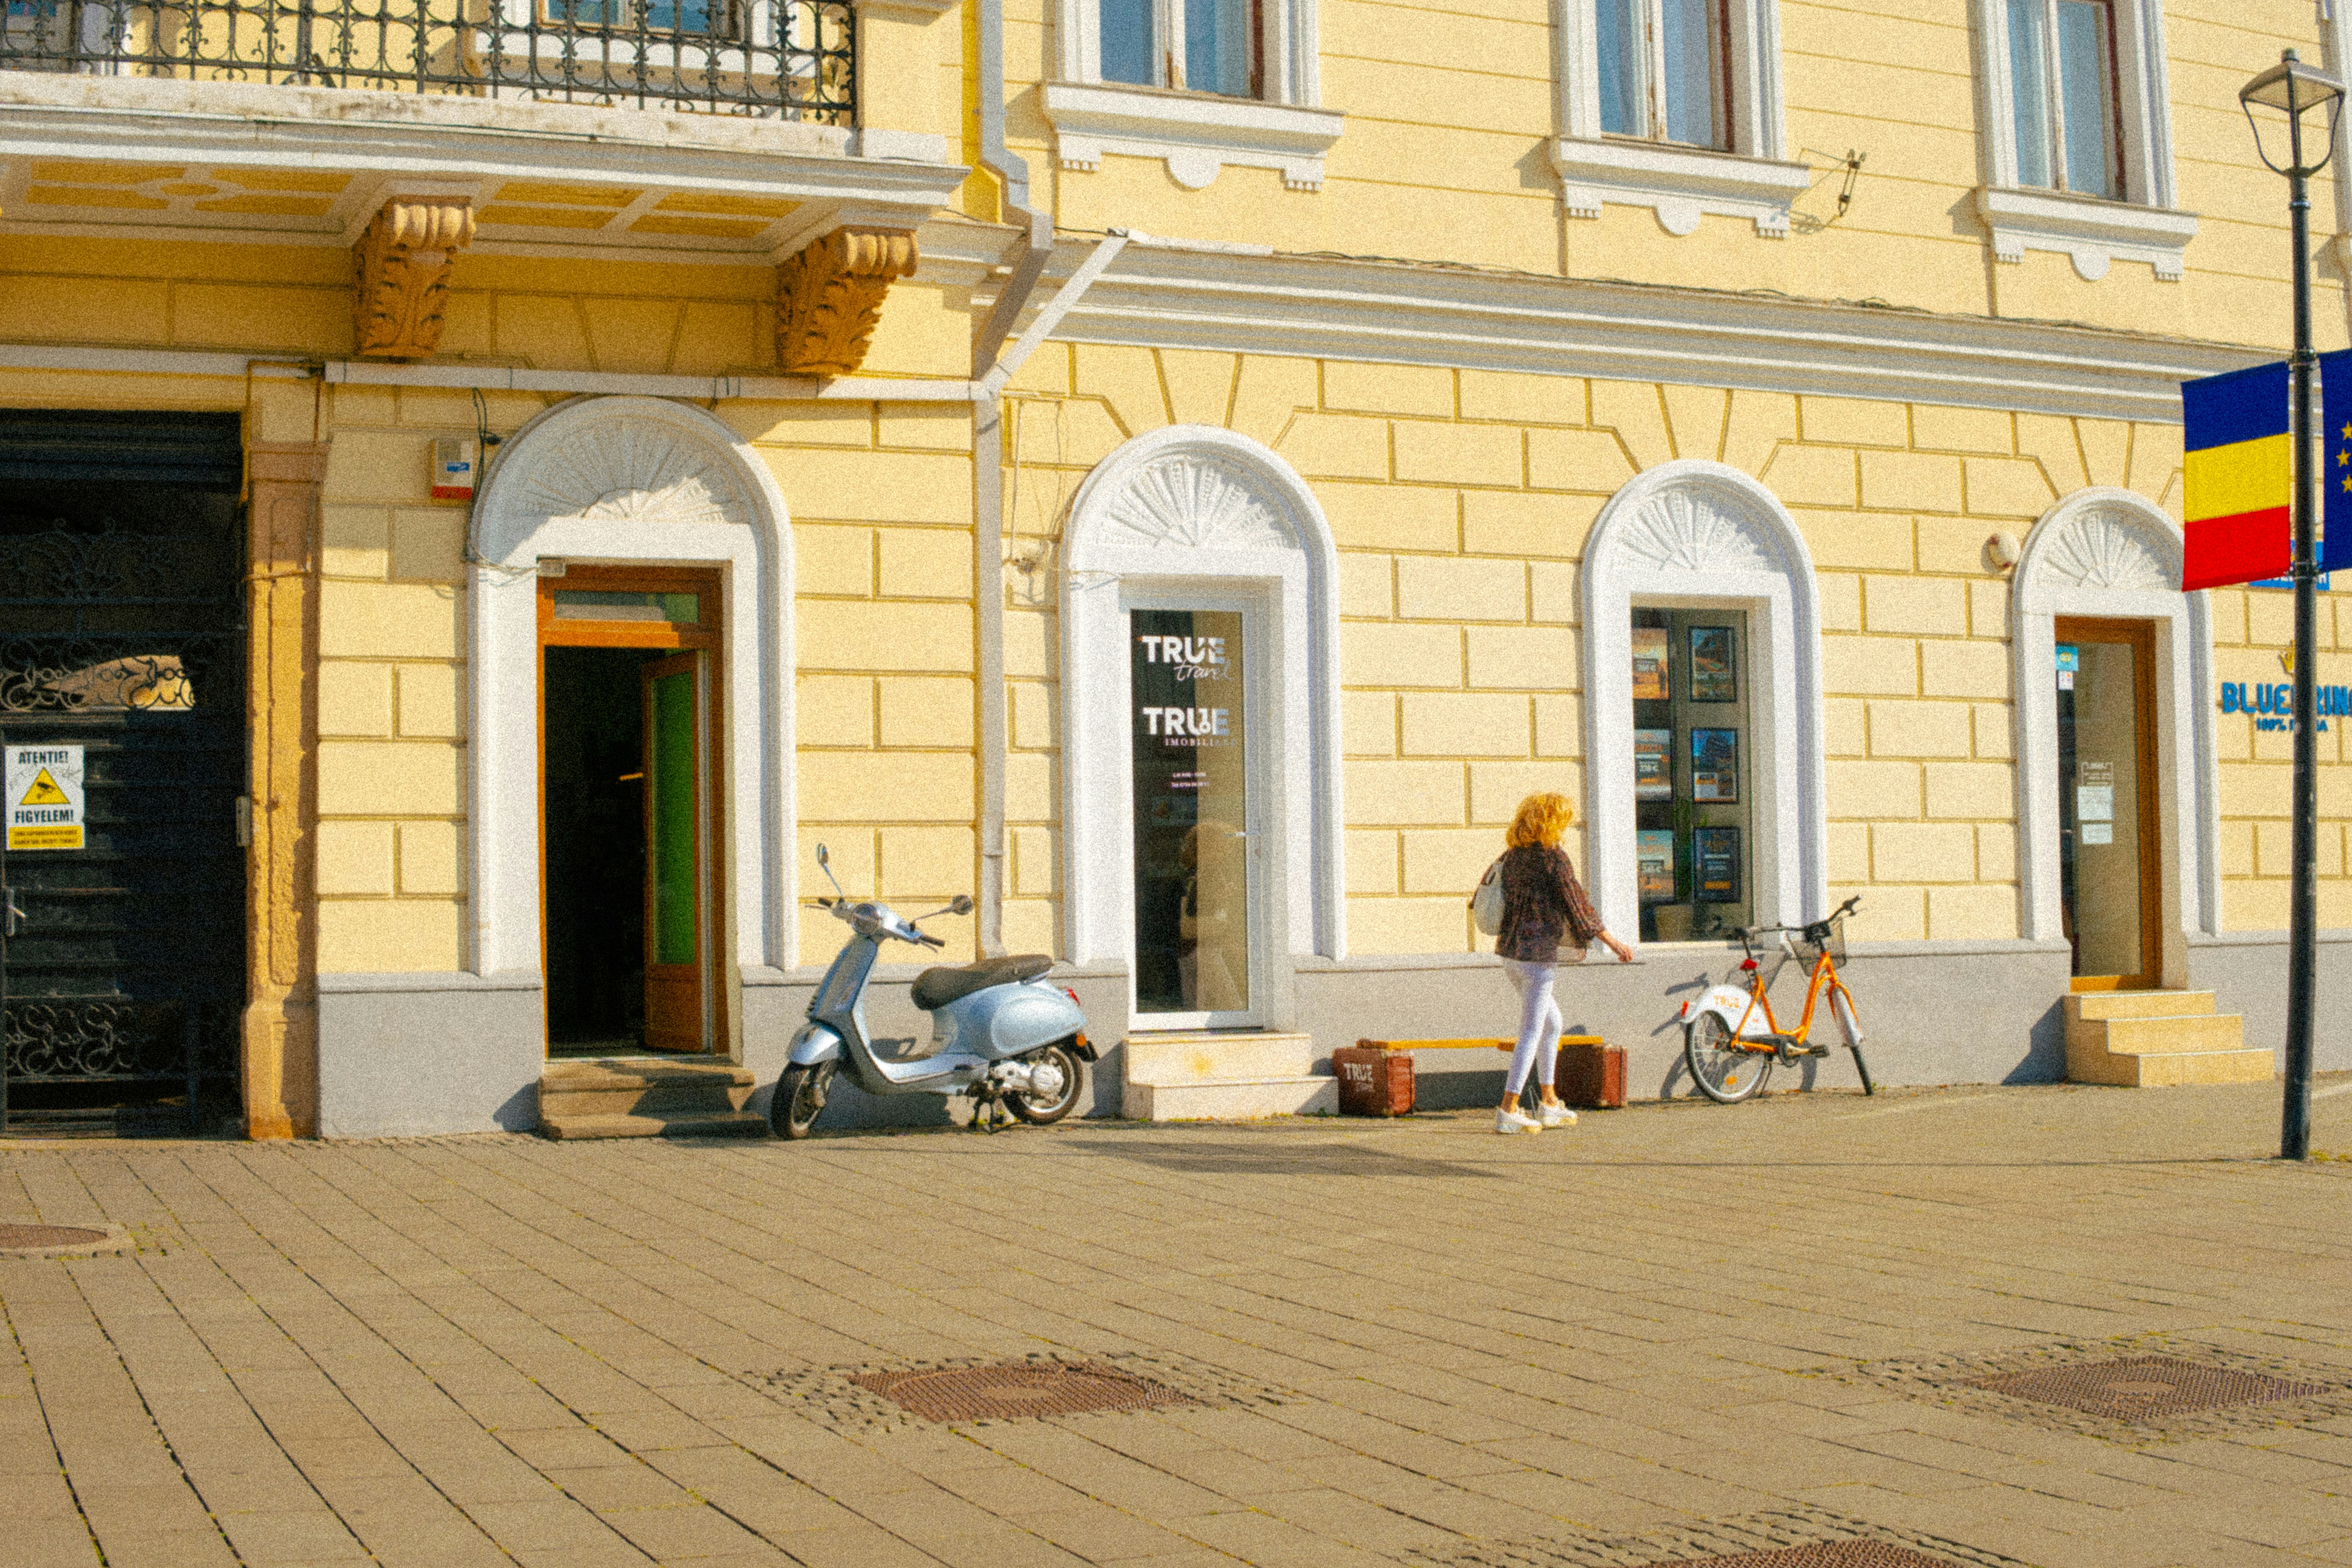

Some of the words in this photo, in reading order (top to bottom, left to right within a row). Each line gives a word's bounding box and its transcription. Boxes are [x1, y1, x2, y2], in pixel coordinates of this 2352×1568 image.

[1141, 635, 1225, 664] TRUE
[1174, 660, 1235, 682] travel
[1143, 707, 1230, 736] TRUE
[15, 809, 74, 823] FIGYELEM!
[1343, 1063, 1374, 1082] TRUE
